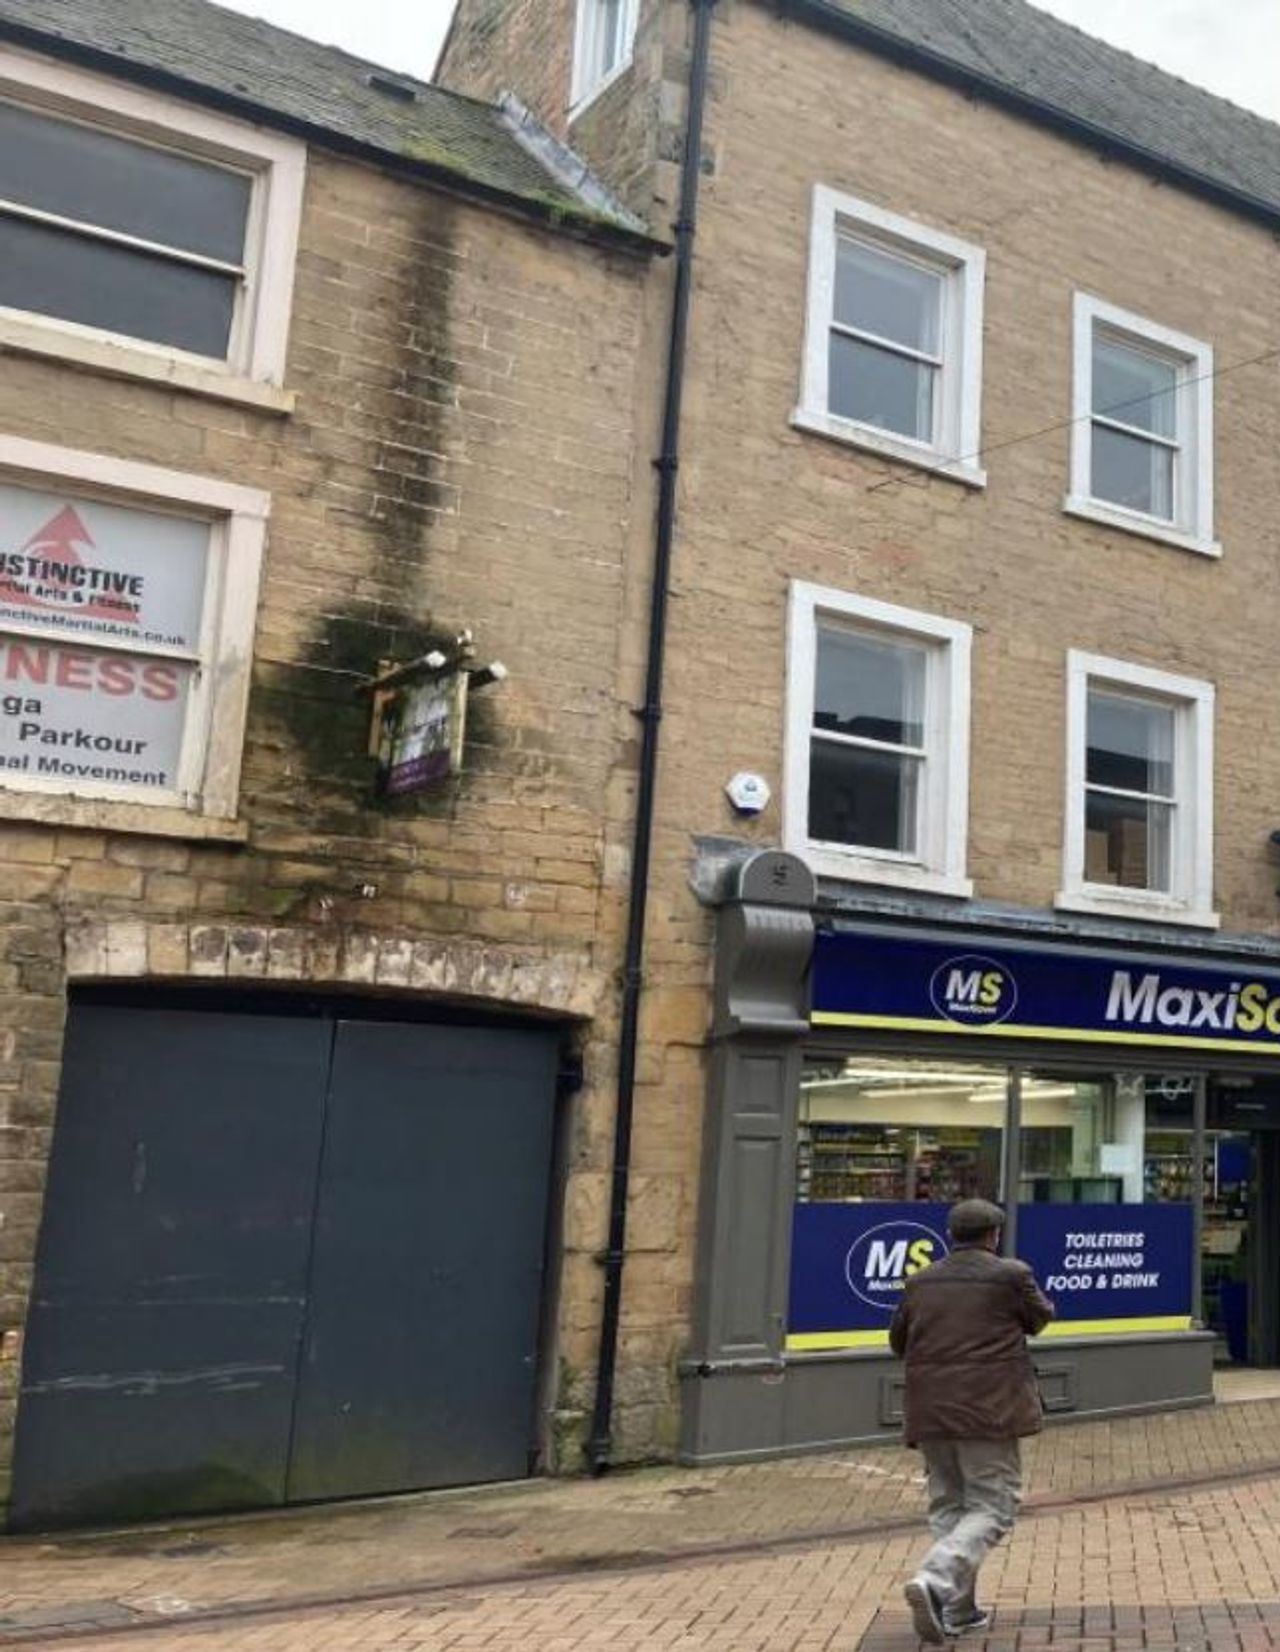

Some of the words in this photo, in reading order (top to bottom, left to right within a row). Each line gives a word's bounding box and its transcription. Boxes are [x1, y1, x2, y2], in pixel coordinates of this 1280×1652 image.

[35, 585, 67, 601] Arts
[72, 591, 84, 604] &
[0, 640, 179, 703] NESS
[18, 721, 149, 755] Parkour
[37, 756, 168, 786] Movement
[945, 969, 1004, 1004] MS
[1065, 1232, 1145, 1249] TOILETRIES
[864, 1239, 934, 1278] MS
[1064, 1252, 1144, 1270] CLEANING
[1045, 1273, 1092, 1291] FOOD
[1095, 1274, 1108, 1290] &
[1111, 1272, 1160, 1289] DRINK
